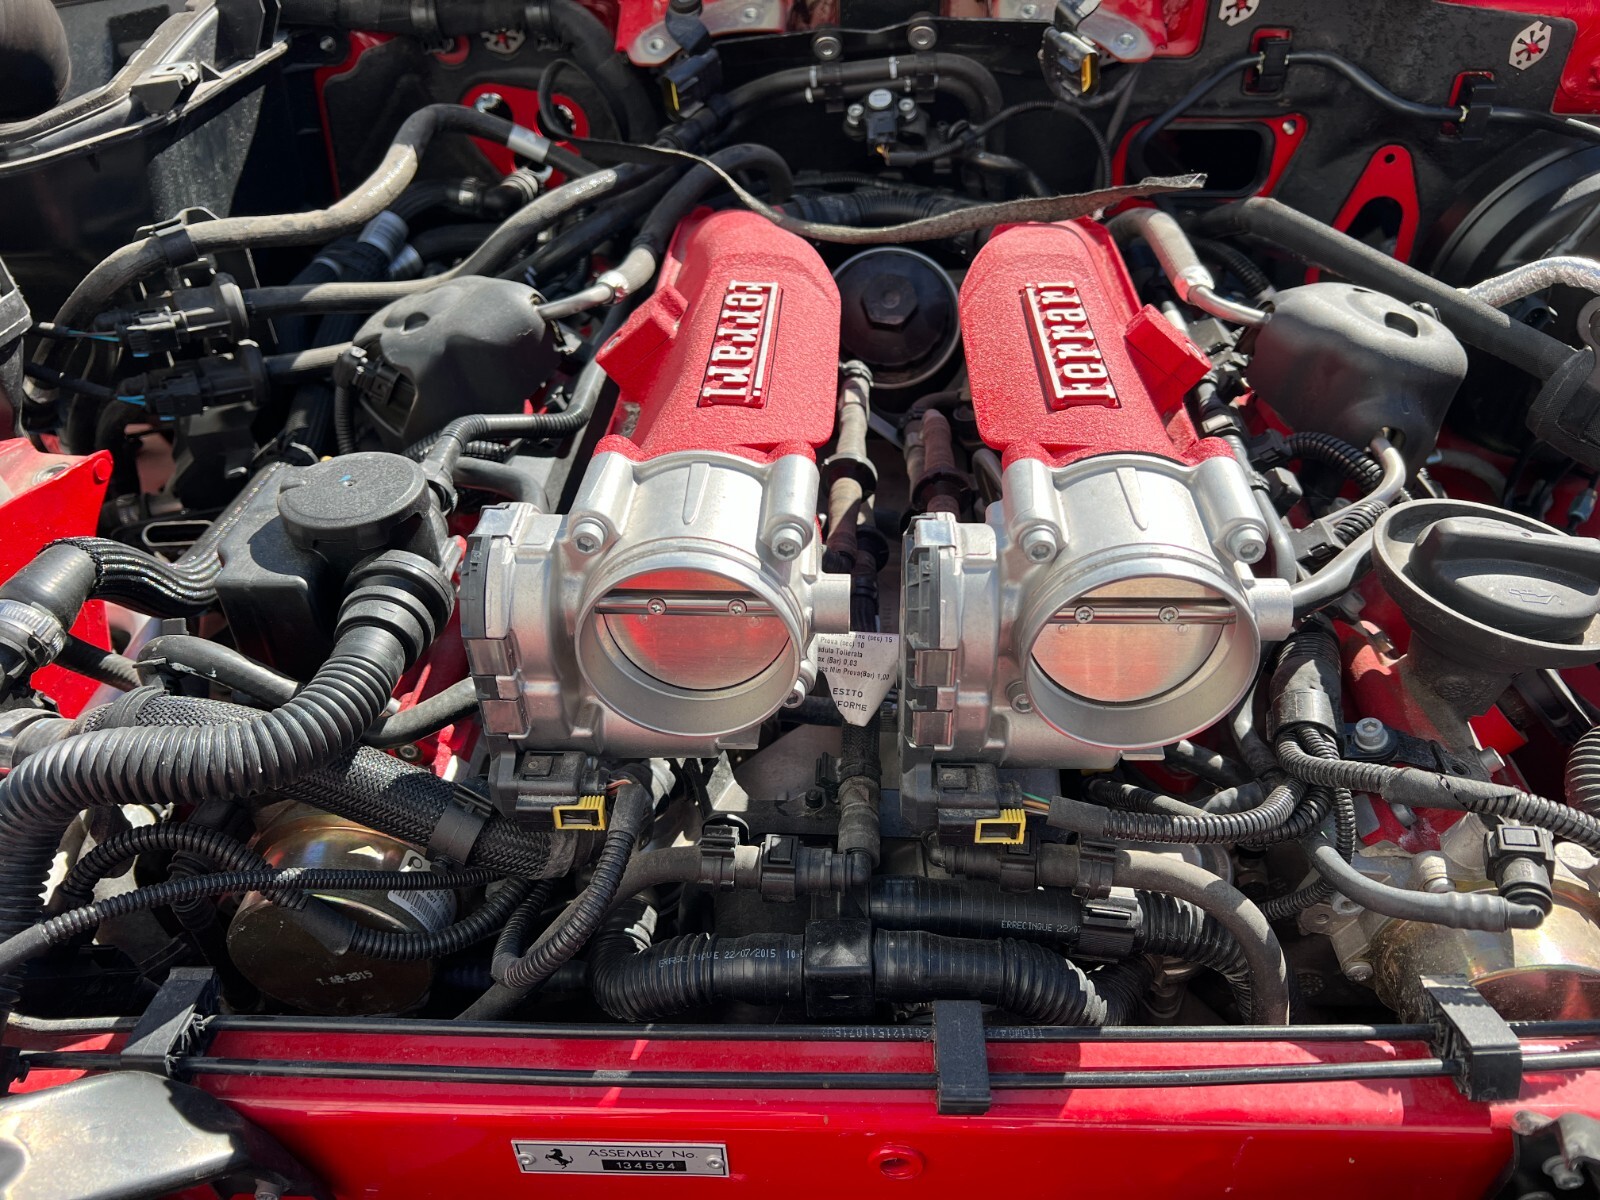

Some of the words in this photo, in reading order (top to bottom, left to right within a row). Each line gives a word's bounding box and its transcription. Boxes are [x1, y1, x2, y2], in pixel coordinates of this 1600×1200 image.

[702, 279, 778, 398] Ferrari
[1024, 280, 1117, 399] Ferrari
[827, 656, 842, 666] (Bar)
[833, 687, 864, 698] ESITO
[836, 700, 868, 712] FORME
[1001, 920, 1053, 932] ERRECINQUE
[724, 948, 776, 960] 22/07/2015
[588, 1148, 664, 1159] ASSEMBLY
[672, 1150, 699, 1159] No.
[616, 1160, 676, 1171] 134594
